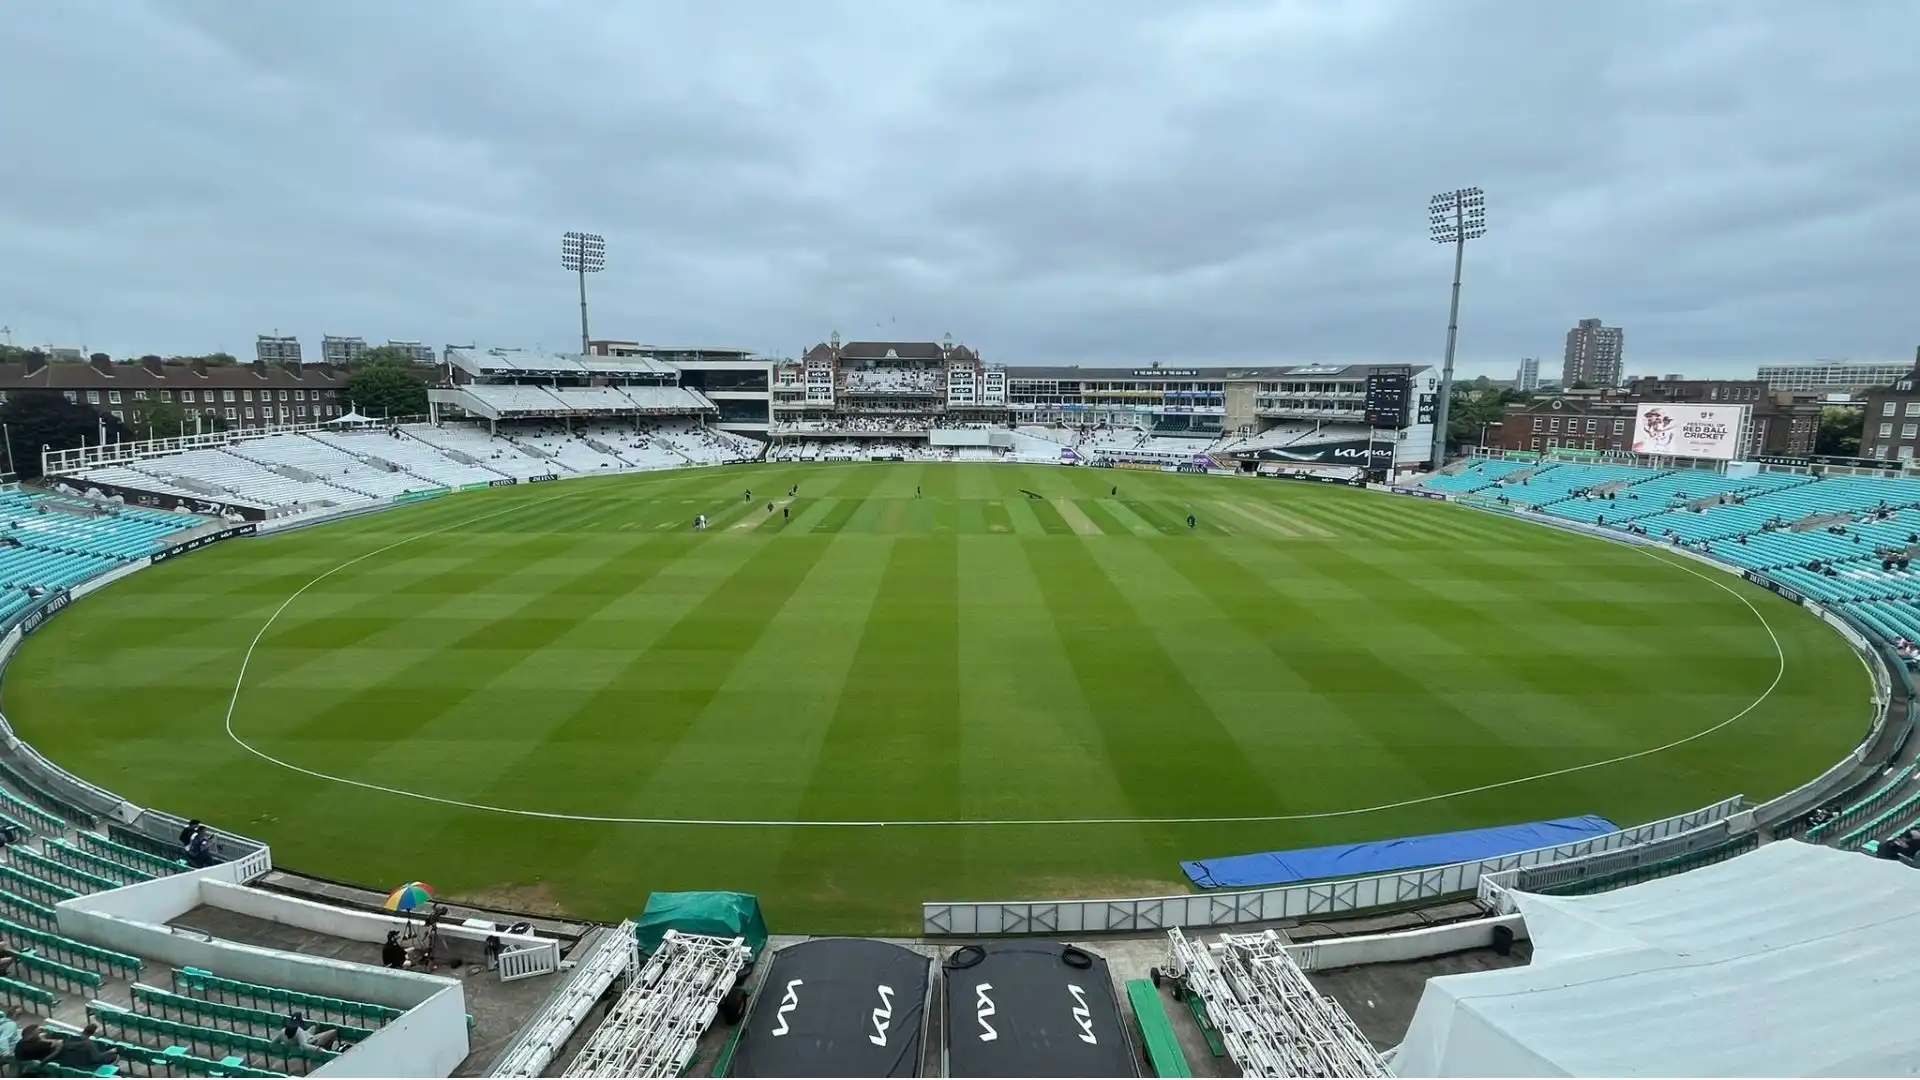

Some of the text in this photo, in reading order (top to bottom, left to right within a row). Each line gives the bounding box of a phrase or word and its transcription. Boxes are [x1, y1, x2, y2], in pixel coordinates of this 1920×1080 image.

[1704, 426, 1728, 434] BALL
[1684, 432, 1724, 440] CRICKET
[1334, 448, 1369, 457] KIA
